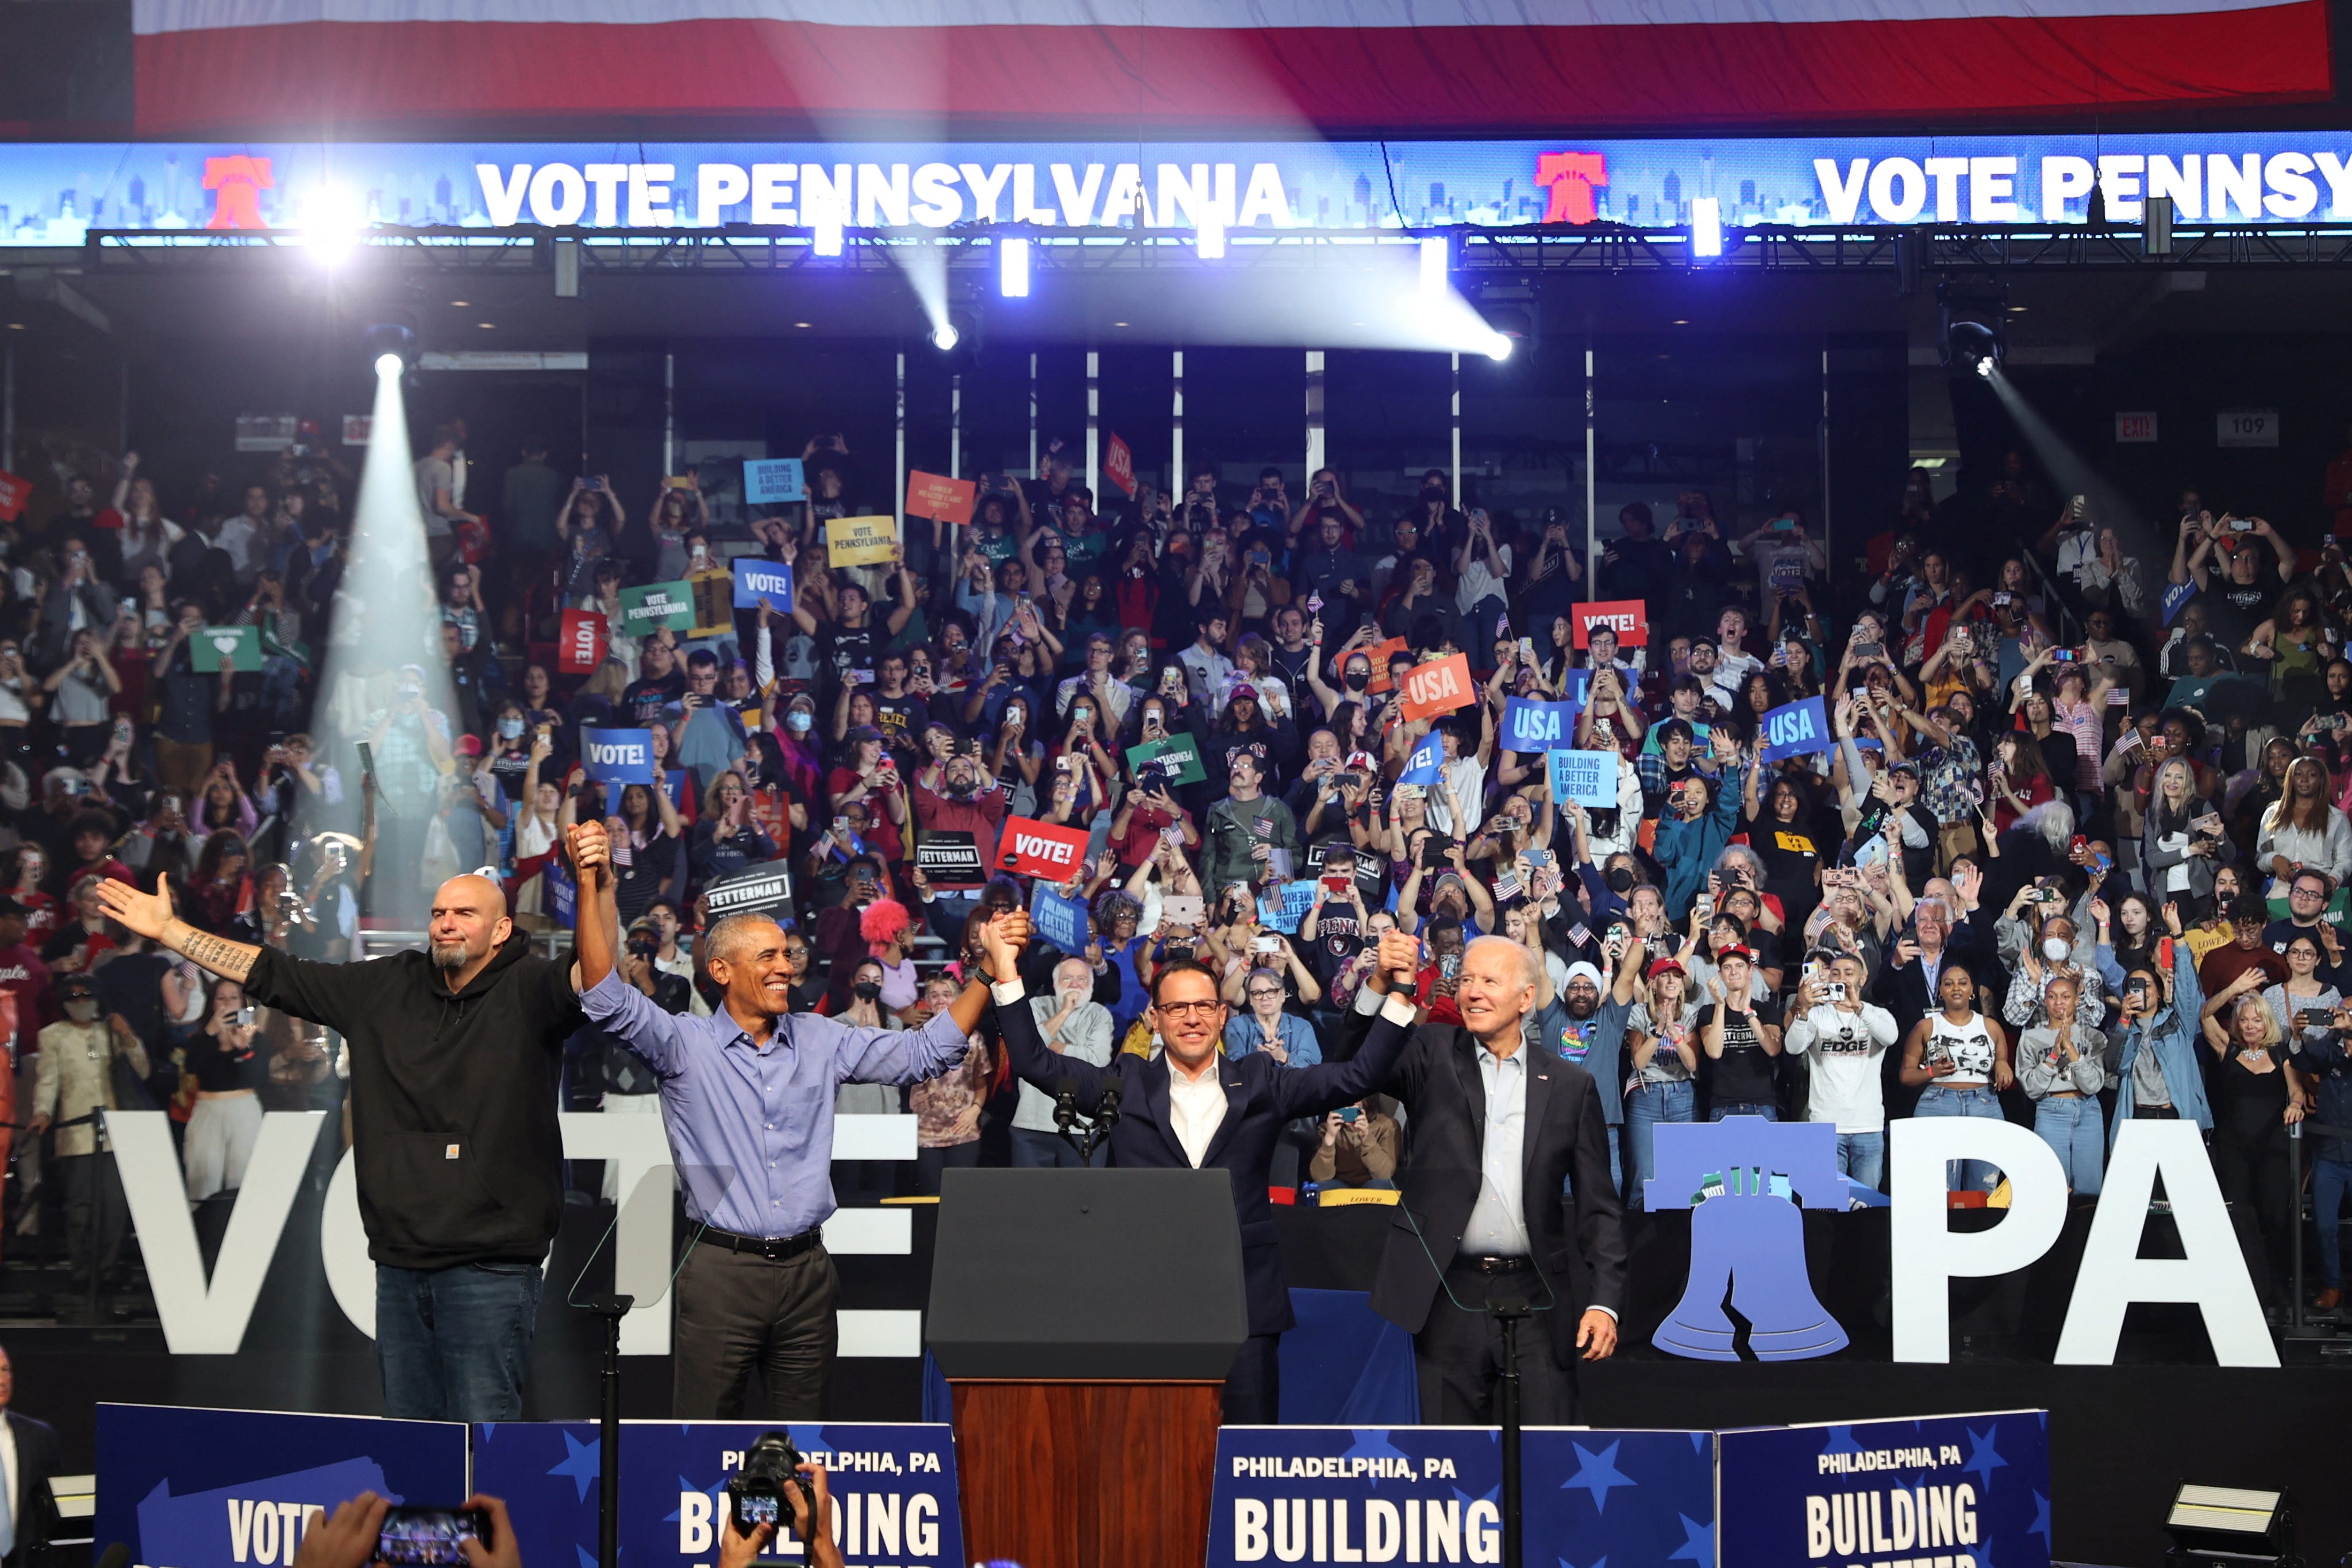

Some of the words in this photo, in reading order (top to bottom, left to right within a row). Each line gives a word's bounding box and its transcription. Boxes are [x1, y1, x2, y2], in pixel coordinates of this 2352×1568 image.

[476, 163, 675, 228] VOTE
[699, 162, 1293, 228] PENNSYLVANIA
[1813, 156, 2018, 224] VOTE
[2123, 417, 2151, 437] EXIT
[2232, 418, 2265, 434] 109
[757, 464, 791, 475] BUILDING
[1108, 442, 1130, 478] USA
[765, 474, 792, 484] BETTER
[760, 484, 792, 495] AMERICA
[834, 535, 891, 549] PENNSYLVANIA
[853, 527, 872, 537] VOTE
[1773, 568, 1806, 578] VOTER
[745, 573, 787, 595] VOTE!
[645, 594, 667, 605] VOTE
[628, 602, 688, 619] PENNSYLVANIA
[1584, 614, 1635, 632] VOTE!
[576, 620, 595, 665] VOTE!
[1409, 666, 1460, 706] USA
[1514, 707, 1561, 741] USA
[1769, 708, 1815, 747] USA
[590, 743, 645, 765] VOTE!
[1401, 746, 1433, 778] OTE!
[1558, 756, 1600, 770] BUILDING
[1165, 768, 1181, 777] VOT
[1559, 770, 1564, 781] A
[1565, 770, 1599, 783] BETTER
[1561, 783, 1598, 796] AMERICA
[920, 850, 975, 863] FETTERMAN
[1015, 833, 1074, 865] VOTE!
[709, 881, 782, 907] FETTERMAN
[1281, 891, 1316, 903] MERIC
[1042, 895, 1074, 920] BUILDING
[1038, 912, 1044, 923] A
[1044, 912, 1074, 932] BETTER
[1276, 916, 1300, 929] DING
[1318, 917, 1362, 938] PENN
[1040, 924, 1075, 947] AMERICA
[2198, 935, 2227, 949] LOWER
[1724, 1031, 1755, 1041] ETTERM
[1820, 1039, 1869, 1052] EDGE
[103, 1111, 922, 1357] VTE
[1890, 1116, 2281, 1367] PA
[909, 1452, 941, 1473] PA
[1233, 1457, 1418, 1482] PHILADELPHIA,
[1425, 1458, 1457, 1478] PA
[1818, 1448, 1937, 1474] PHILADELPHIA,
[1940, 1445, 1961, 1466] PA
[1235, 1498, 1500, 1563] BUILDING
[1806, 1483, 1977, 1559] BUILDING
